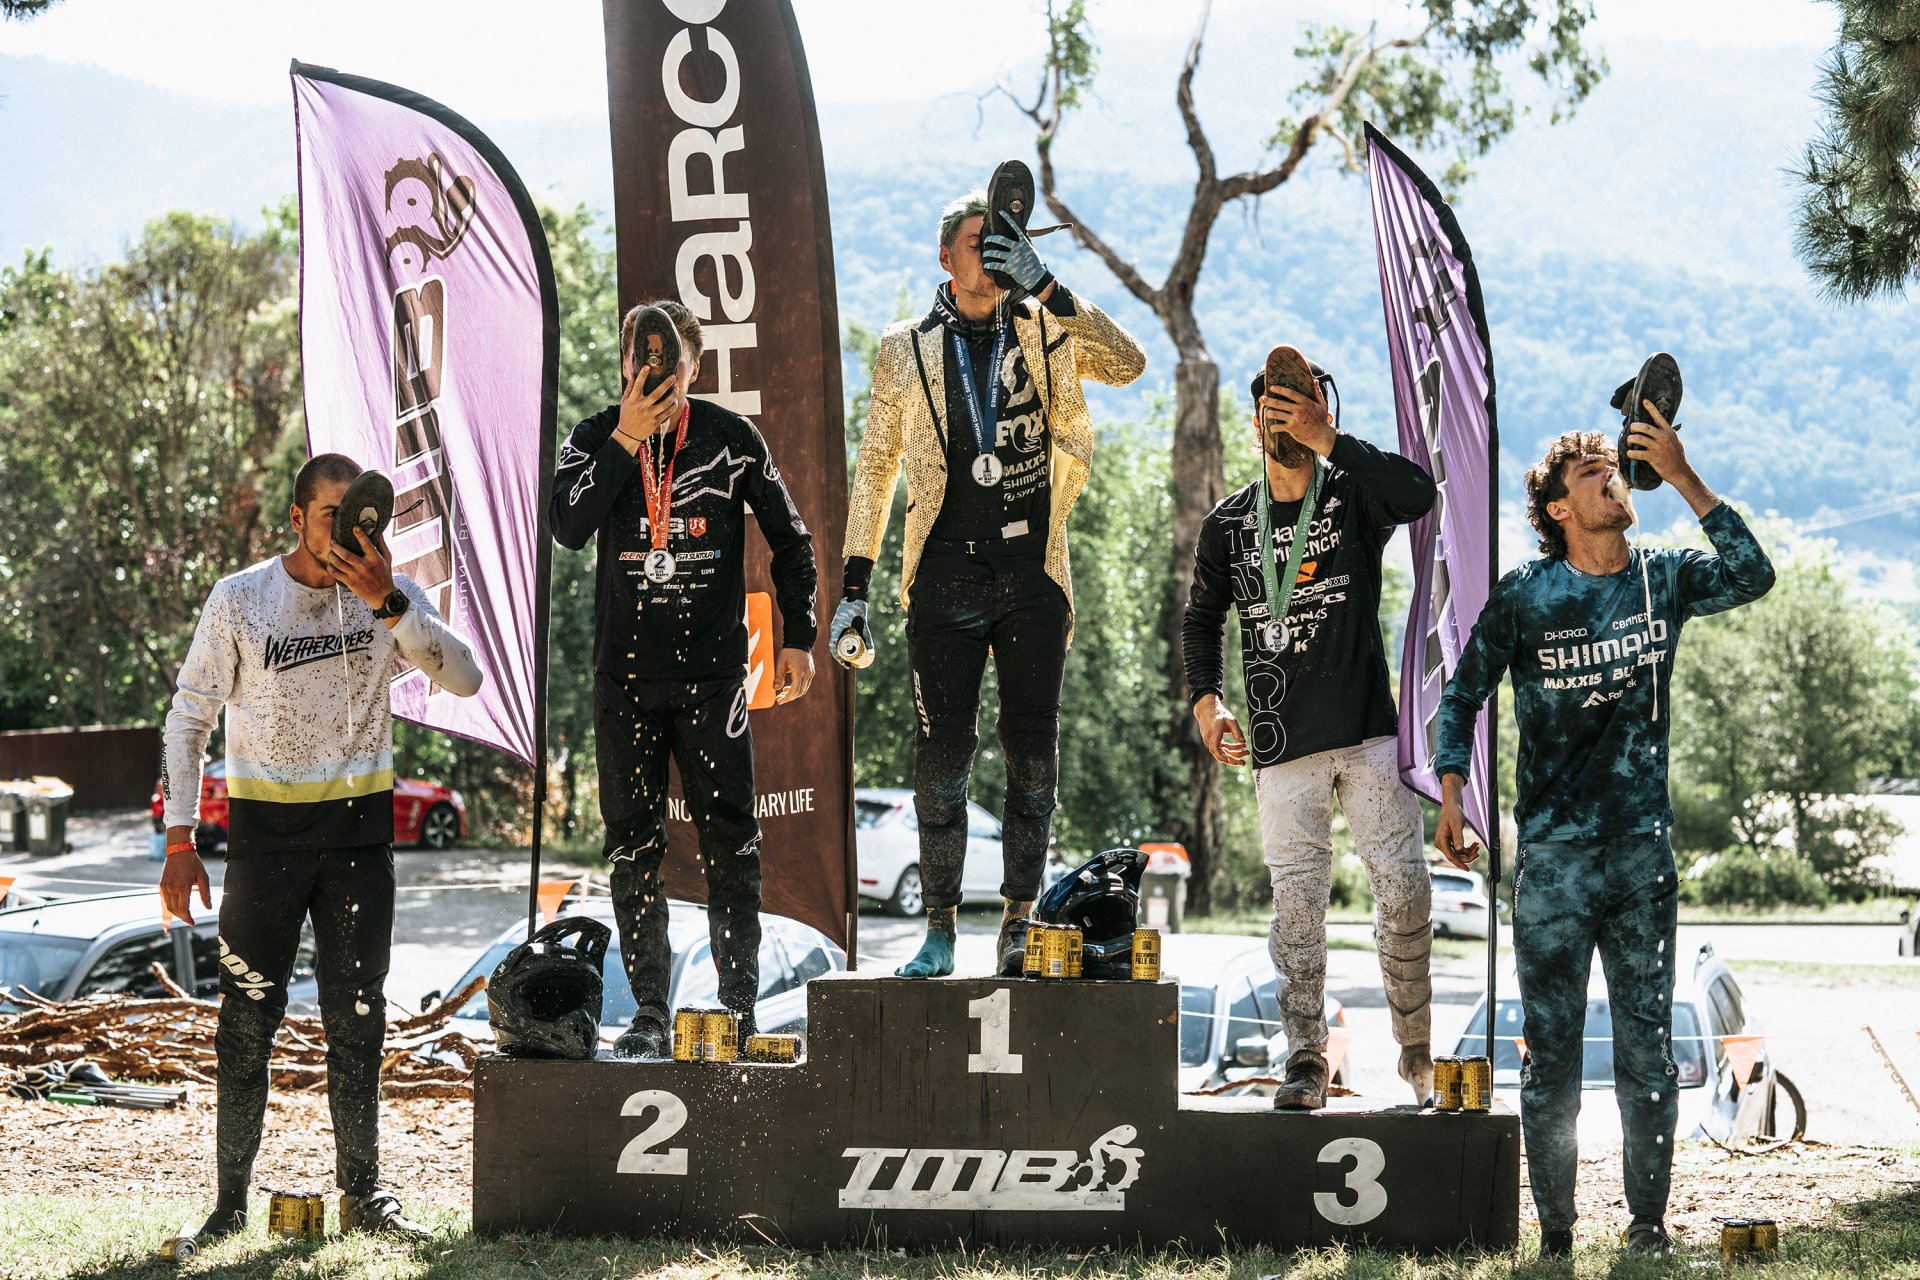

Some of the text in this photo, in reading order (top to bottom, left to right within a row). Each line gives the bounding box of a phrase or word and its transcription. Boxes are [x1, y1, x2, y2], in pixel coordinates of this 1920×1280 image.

[962, 372, 971, 394] SERIES
[995, 409, 1045, 453] FOX
[982, 455, 992, 473] 1
[1003, 451, 1046, 477] MAXXS
[1003, 466, 1048, 490] SHIMAO
[619, 551, 650, 561] KEN
[653, 553, 667, 570] 2
[1266, 577, 1274, 598] SERIES
[1271, 624, 1283, 640] 3
[1543, 672, 1602, 690] MAXXIS
[790, 788, 814, 814] LIFE
[967, 988, 1023, 1074] 1
[617, 1089, 689, 1175] 2
[1313, 1137, 1387, 1226] 3
